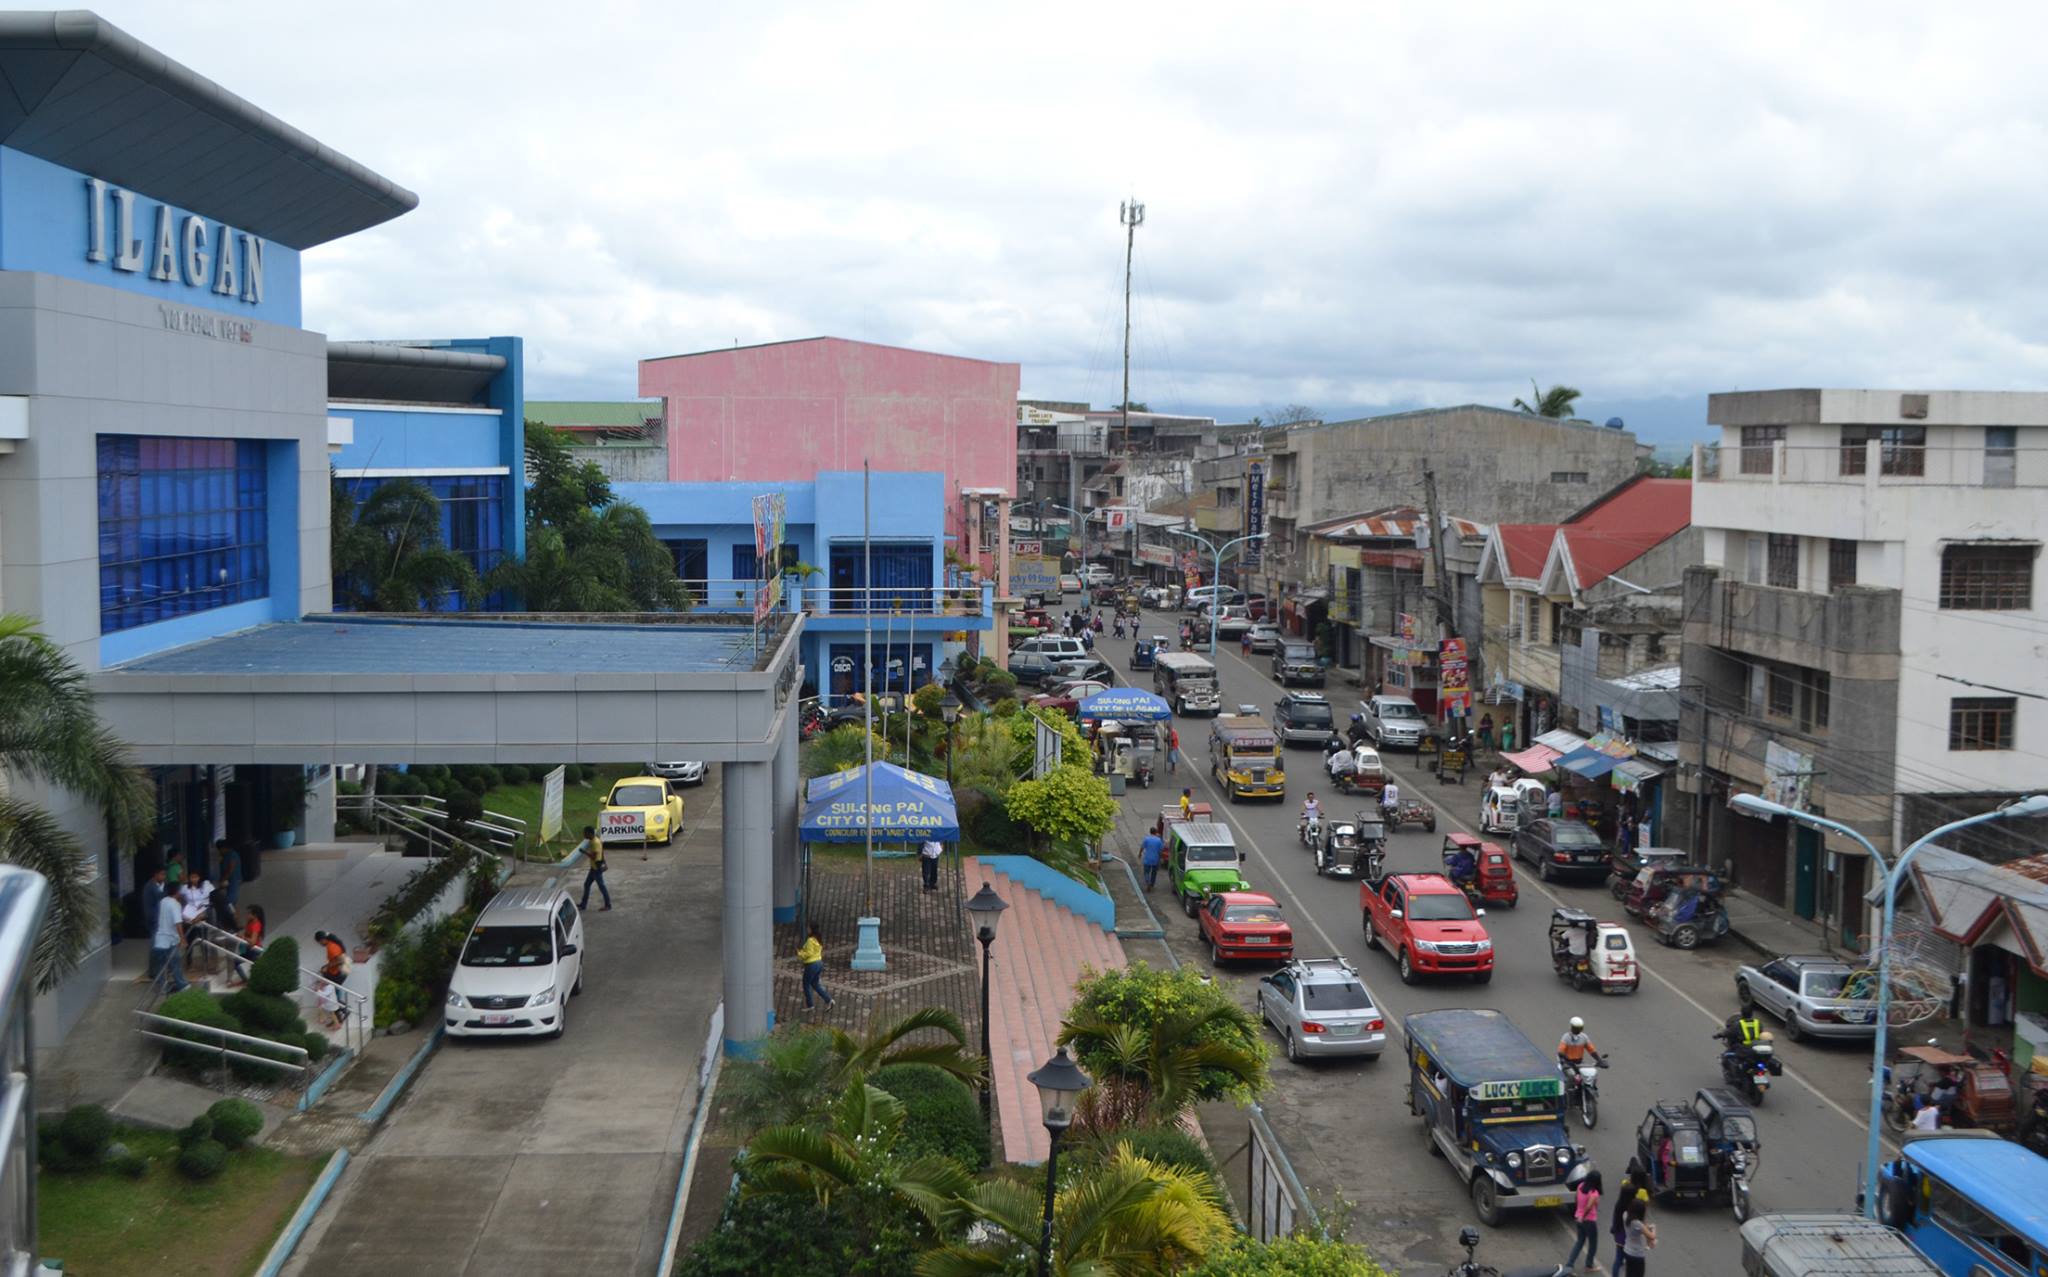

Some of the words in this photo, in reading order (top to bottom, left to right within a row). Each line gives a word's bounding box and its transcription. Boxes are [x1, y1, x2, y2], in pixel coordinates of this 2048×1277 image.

[86, 177, 266, 304] ILAGAN
[1016, 543, 1040, 553] LBC
[831, 802, 892, 814] SULONG
[608, 814, 637, 825] NO
[816, 815, 853, 825] CITY
[880, 815, 943, 826] ILAGAN
[601, 825, 645, 835] PARKING
[1484, 1082, 1521, 1098] LUCKY
[1525, 1080, 1556, 1097] LUCK
